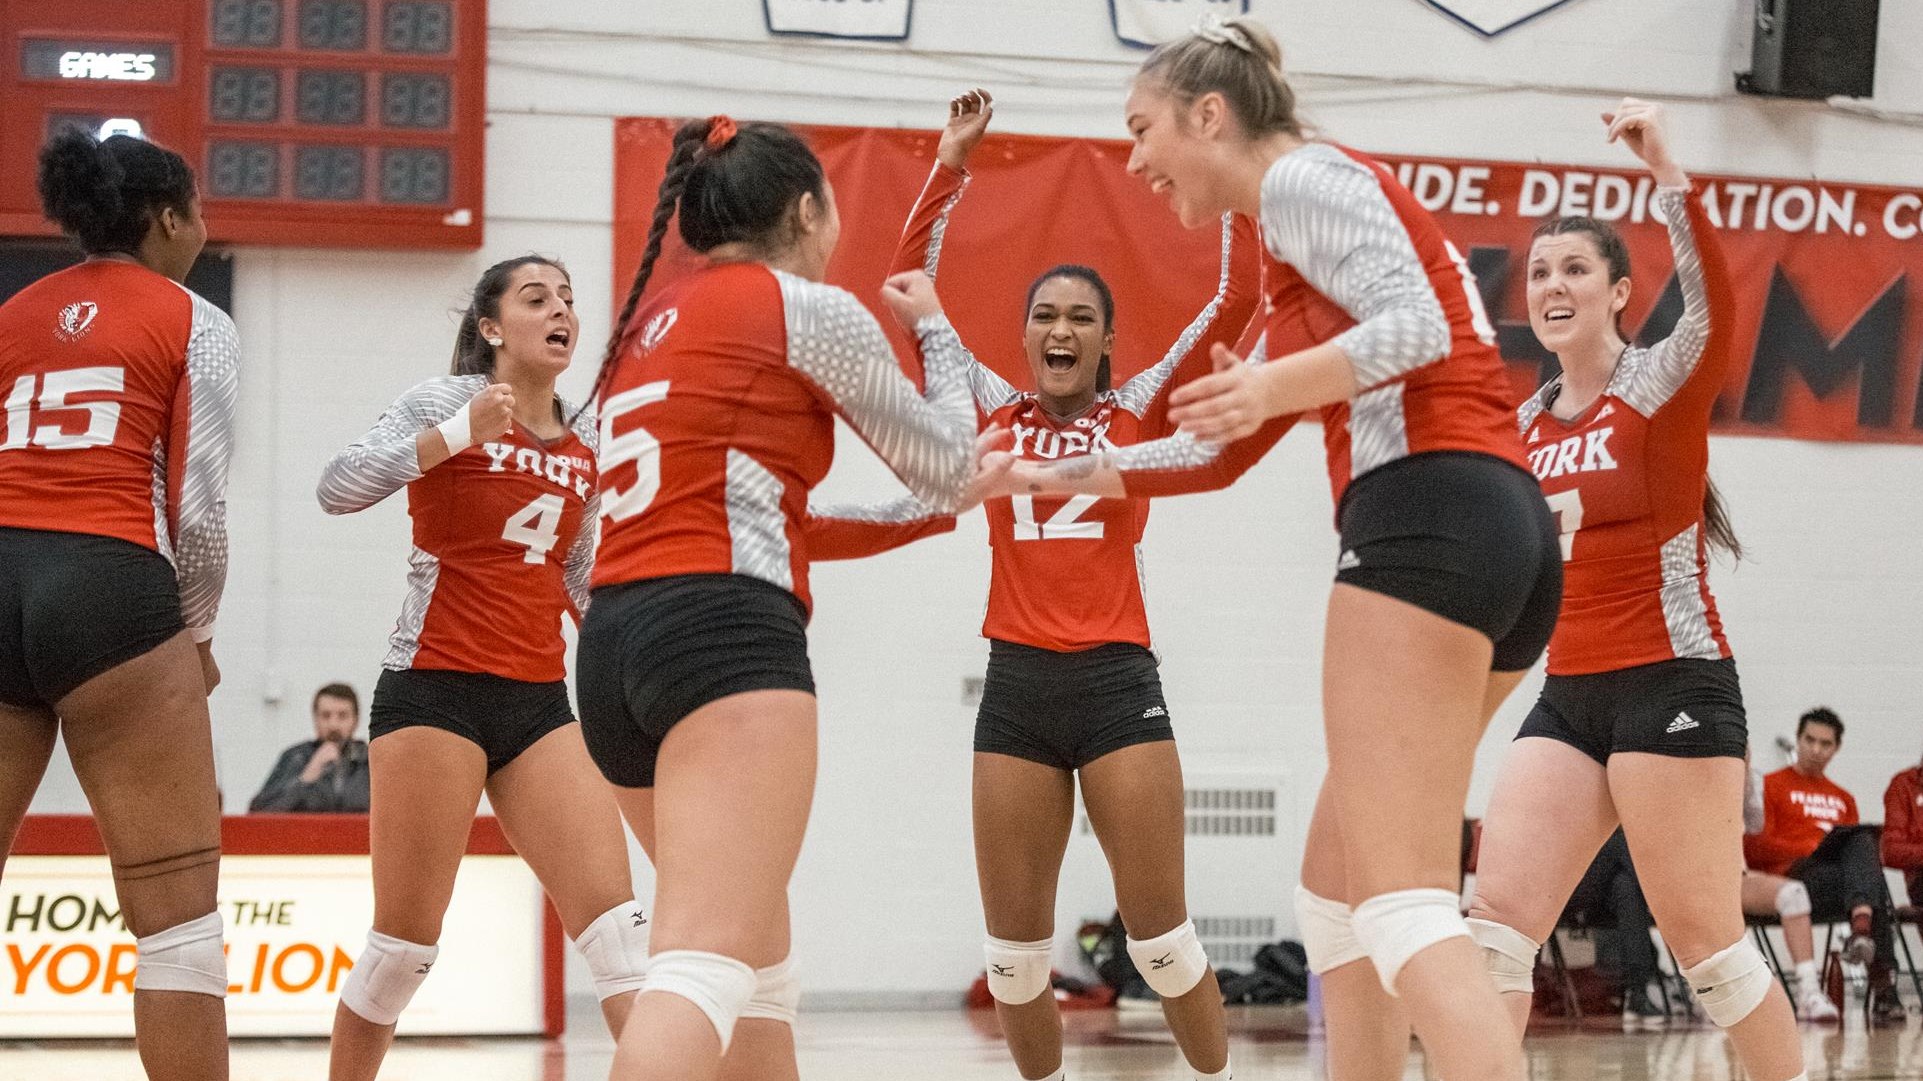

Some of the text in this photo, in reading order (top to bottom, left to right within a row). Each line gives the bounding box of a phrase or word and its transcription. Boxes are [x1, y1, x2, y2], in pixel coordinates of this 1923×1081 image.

[59, 51, 156, 81] GAMES
[1372, 161, 1501, 216] IDE.
[0, 366, 125, 451] 15
[502, 492, 566, 565] 4
[1011, 494, 1105, 541] 12
[6, 895, 296, 932] HOM THE
[5, 943, 355, 995] YOR ION
